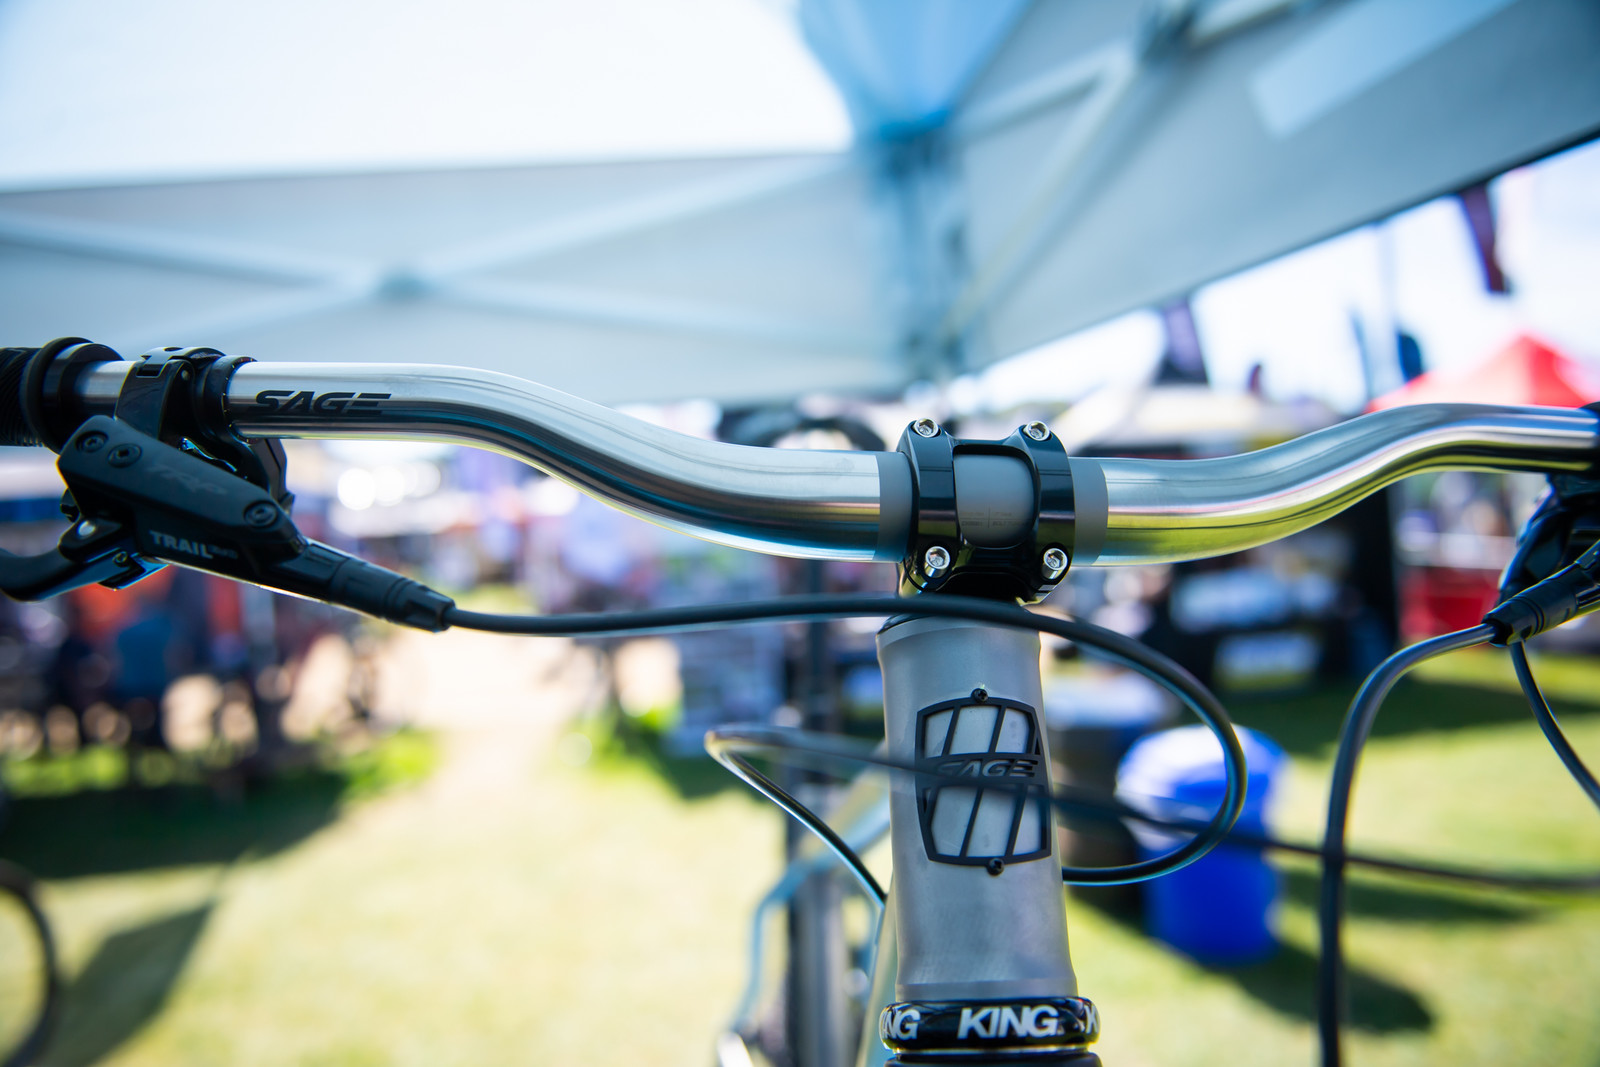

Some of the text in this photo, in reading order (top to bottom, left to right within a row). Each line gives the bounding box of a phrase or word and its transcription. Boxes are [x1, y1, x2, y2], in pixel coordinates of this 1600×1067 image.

[248, 390, 391, 414] SAGE
[149, 530, 213, 559] TRAIL
[957, 1005, 1059, 1039] KING
